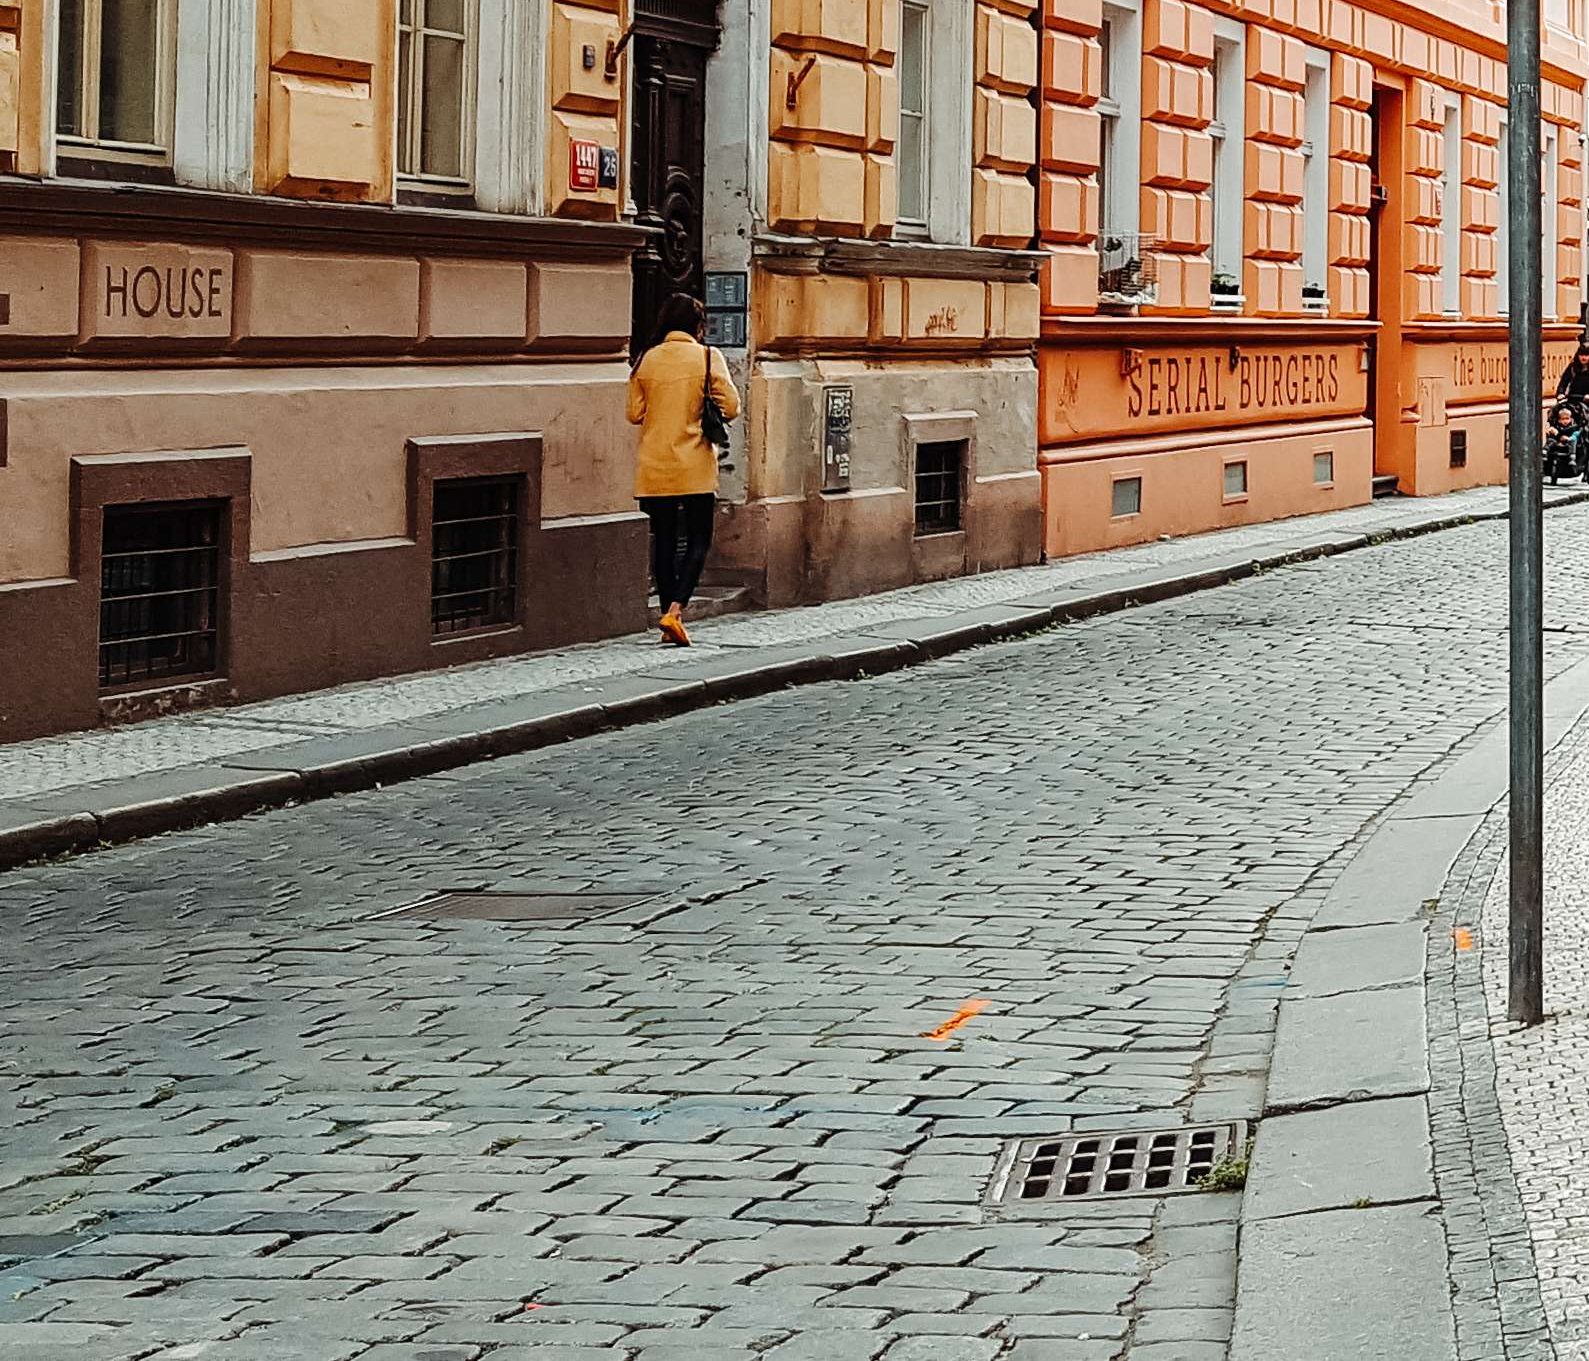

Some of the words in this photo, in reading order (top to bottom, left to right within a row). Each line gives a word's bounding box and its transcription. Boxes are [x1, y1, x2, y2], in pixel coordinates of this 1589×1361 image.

[104, 265, 223, 318] HOUSE
[1128, 356, 1227, 418] SERIAL
[1239, 353, 1339, 409] BURGERS
[1453, 346, 1474, 387] the
[1480, 345, 1508, 395] burg
